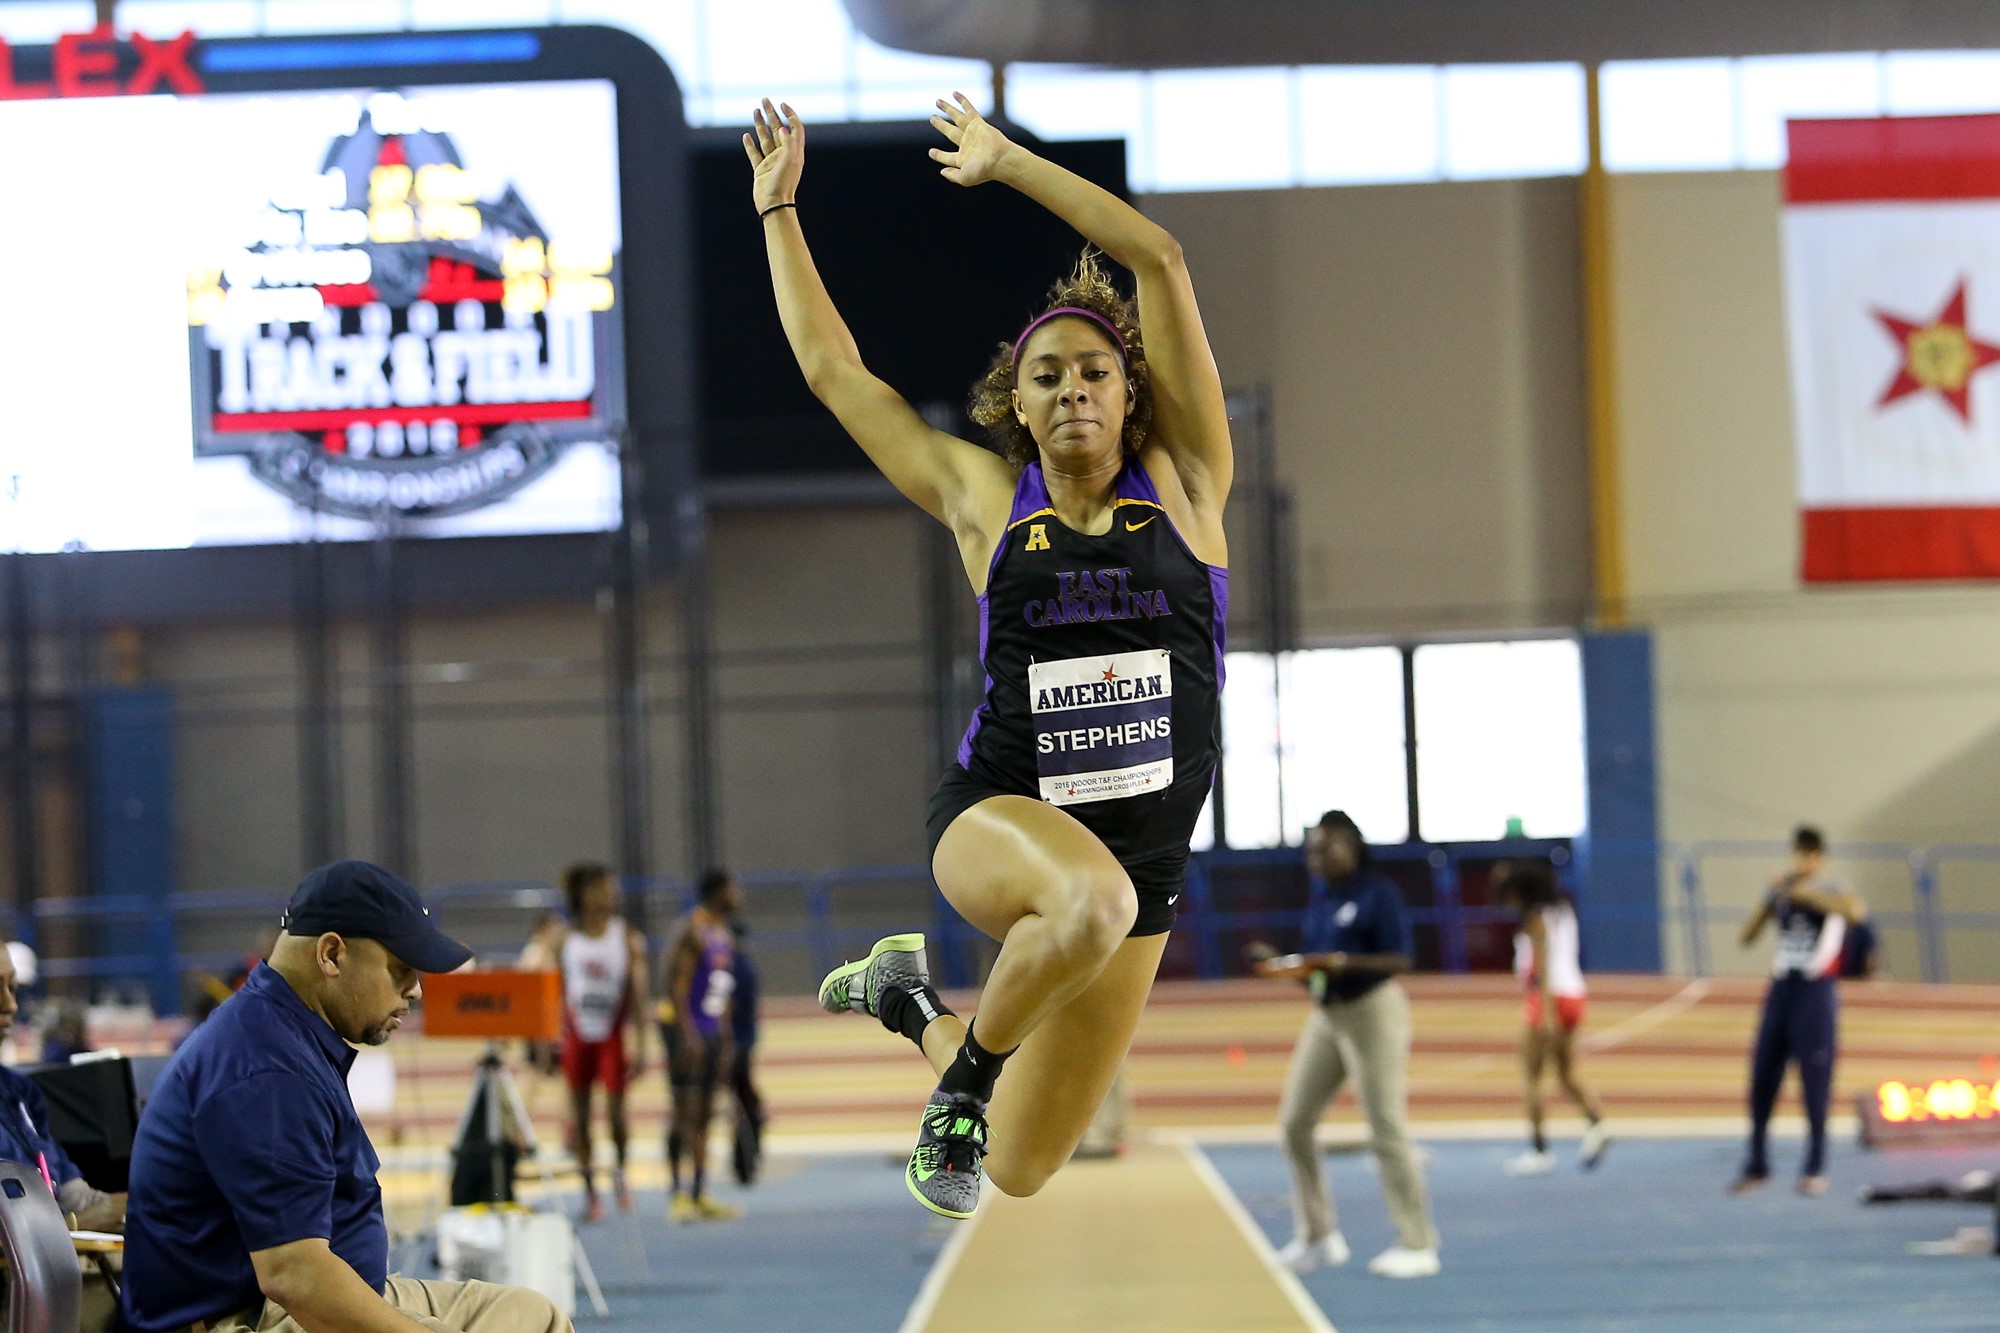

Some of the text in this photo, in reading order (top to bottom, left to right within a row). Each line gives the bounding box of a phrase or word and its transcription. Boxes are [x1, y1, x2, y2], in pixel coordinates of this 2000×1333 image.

[1056, 567, 1132, 597] EAST
[1024, 589, 1172, 627] CAROLINA
[1037, 675, 1162, 710] AMERICAN
[1037, 716, 1171, 754] STEPHENS
[1054, 767, 1162, 789] 2016 INDOOR T&F CHAMPIONSHIPS
[1077, 785, 1113, 795] BIRMINGHAM
